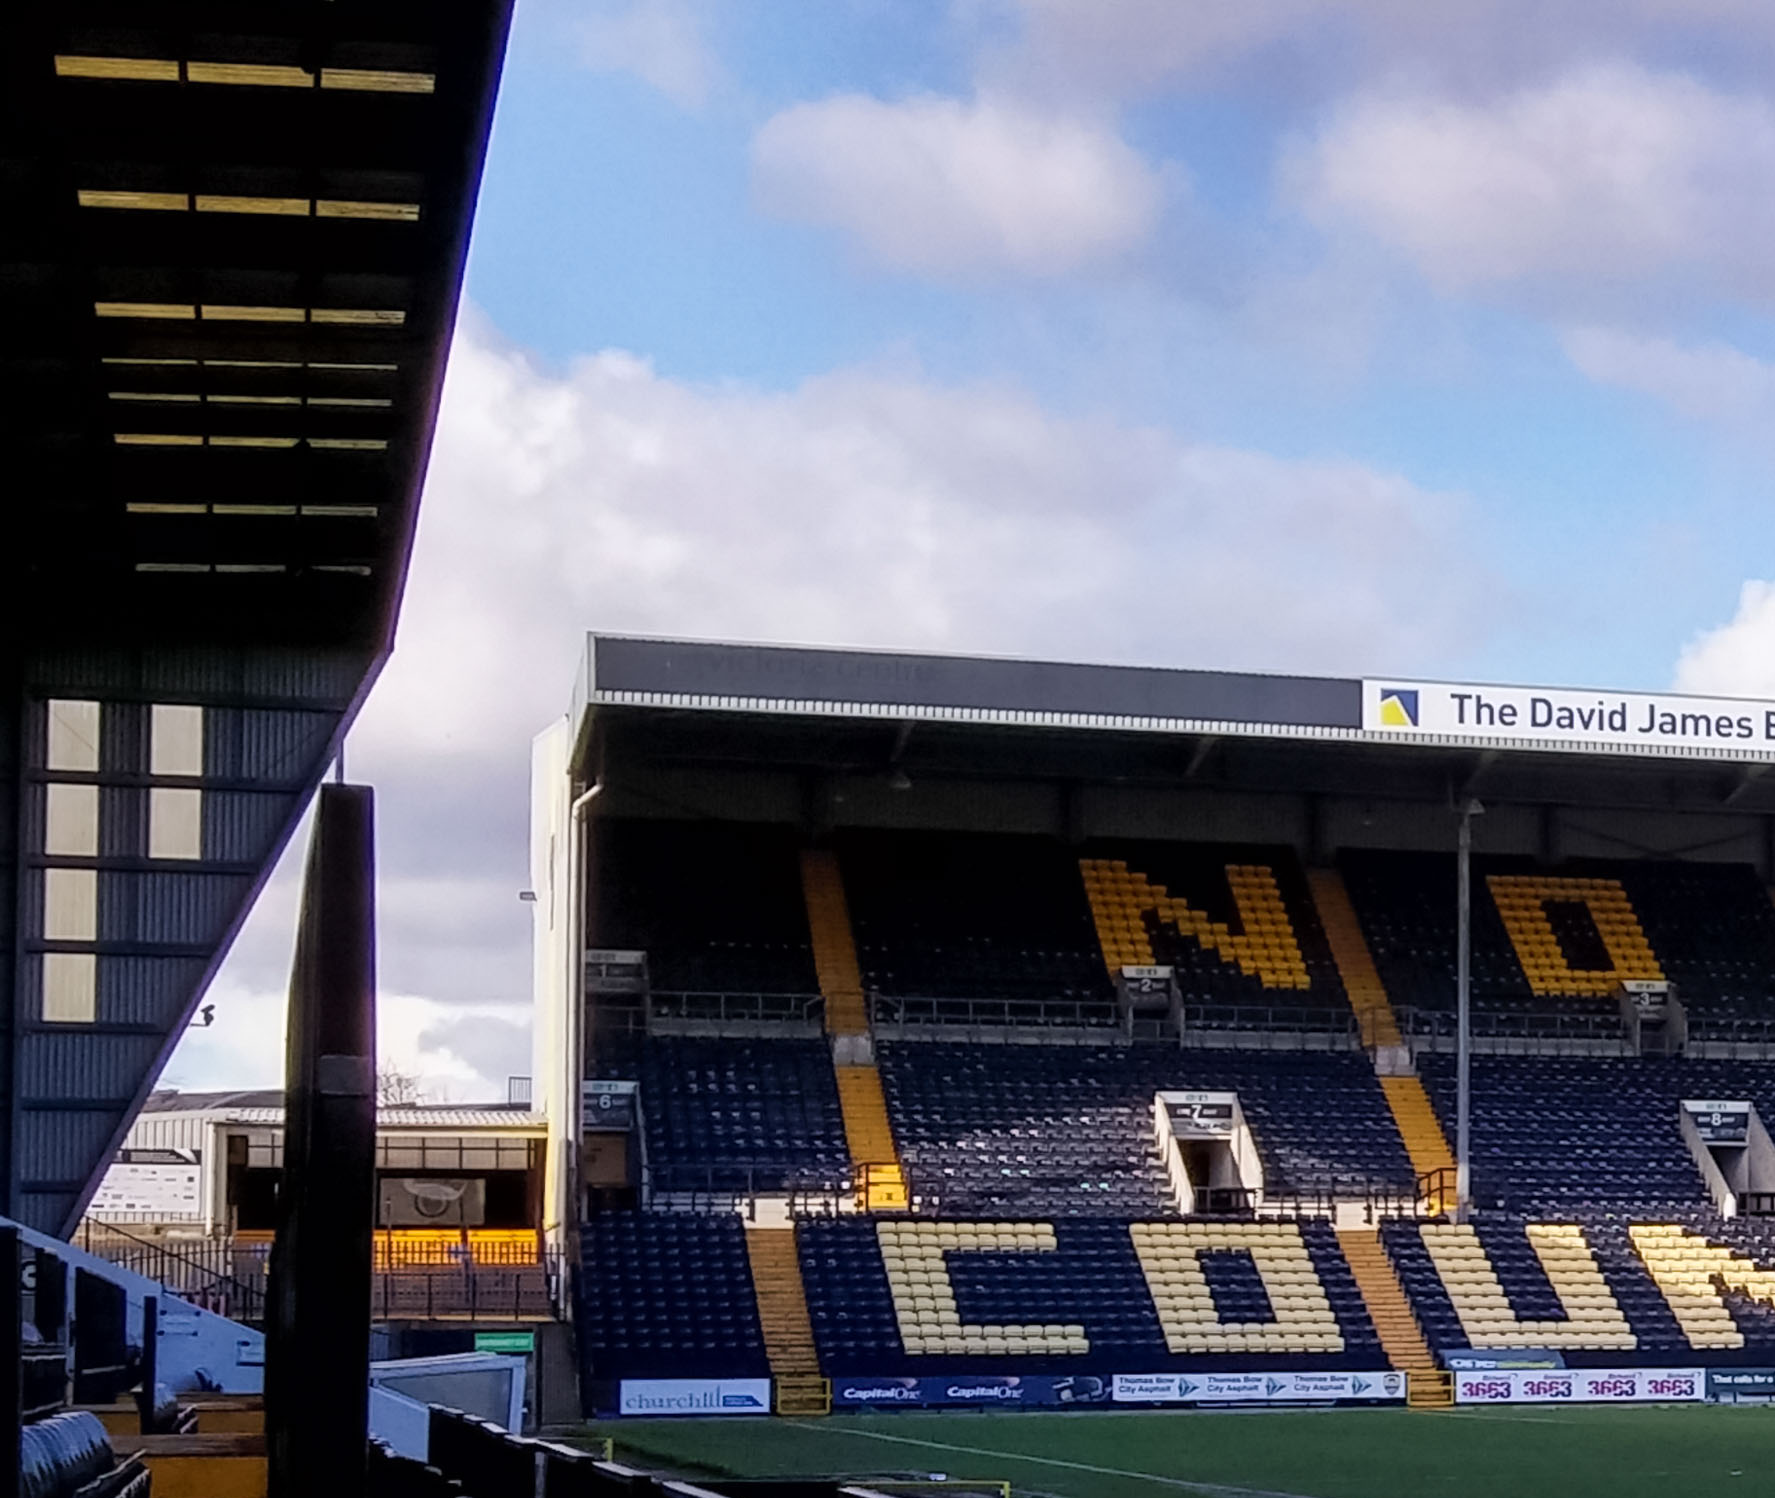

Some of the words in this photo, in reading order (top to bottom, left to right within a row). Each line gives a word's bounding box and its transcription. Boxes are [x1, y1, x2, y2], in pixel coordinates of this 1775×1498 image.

[1450, 692, 1518, 727] The
[1530, 697, 1627, 733] David
[1637, 704, 1754, 740] James
[599, 1094, 612, 1109] 6
[1191, 1104, 1203, 1120] 7
[1711, 1113, 1722, 1126] 8
[1119, 1376, 1153, 1385] Thomas
[1208, 1375, 1242, 1384] Thomas
[1294, 1375, 1328, 1383] Thomas
[625, 1384, 722, 1410] churchill
[1462, 1382, 1511, 1399] 3663
[1523, 1381, 1572, 1398] 3663
[1588, 1380, 1636, 1397] 3663
[1648, 1379, 1695, 1396] 3663
